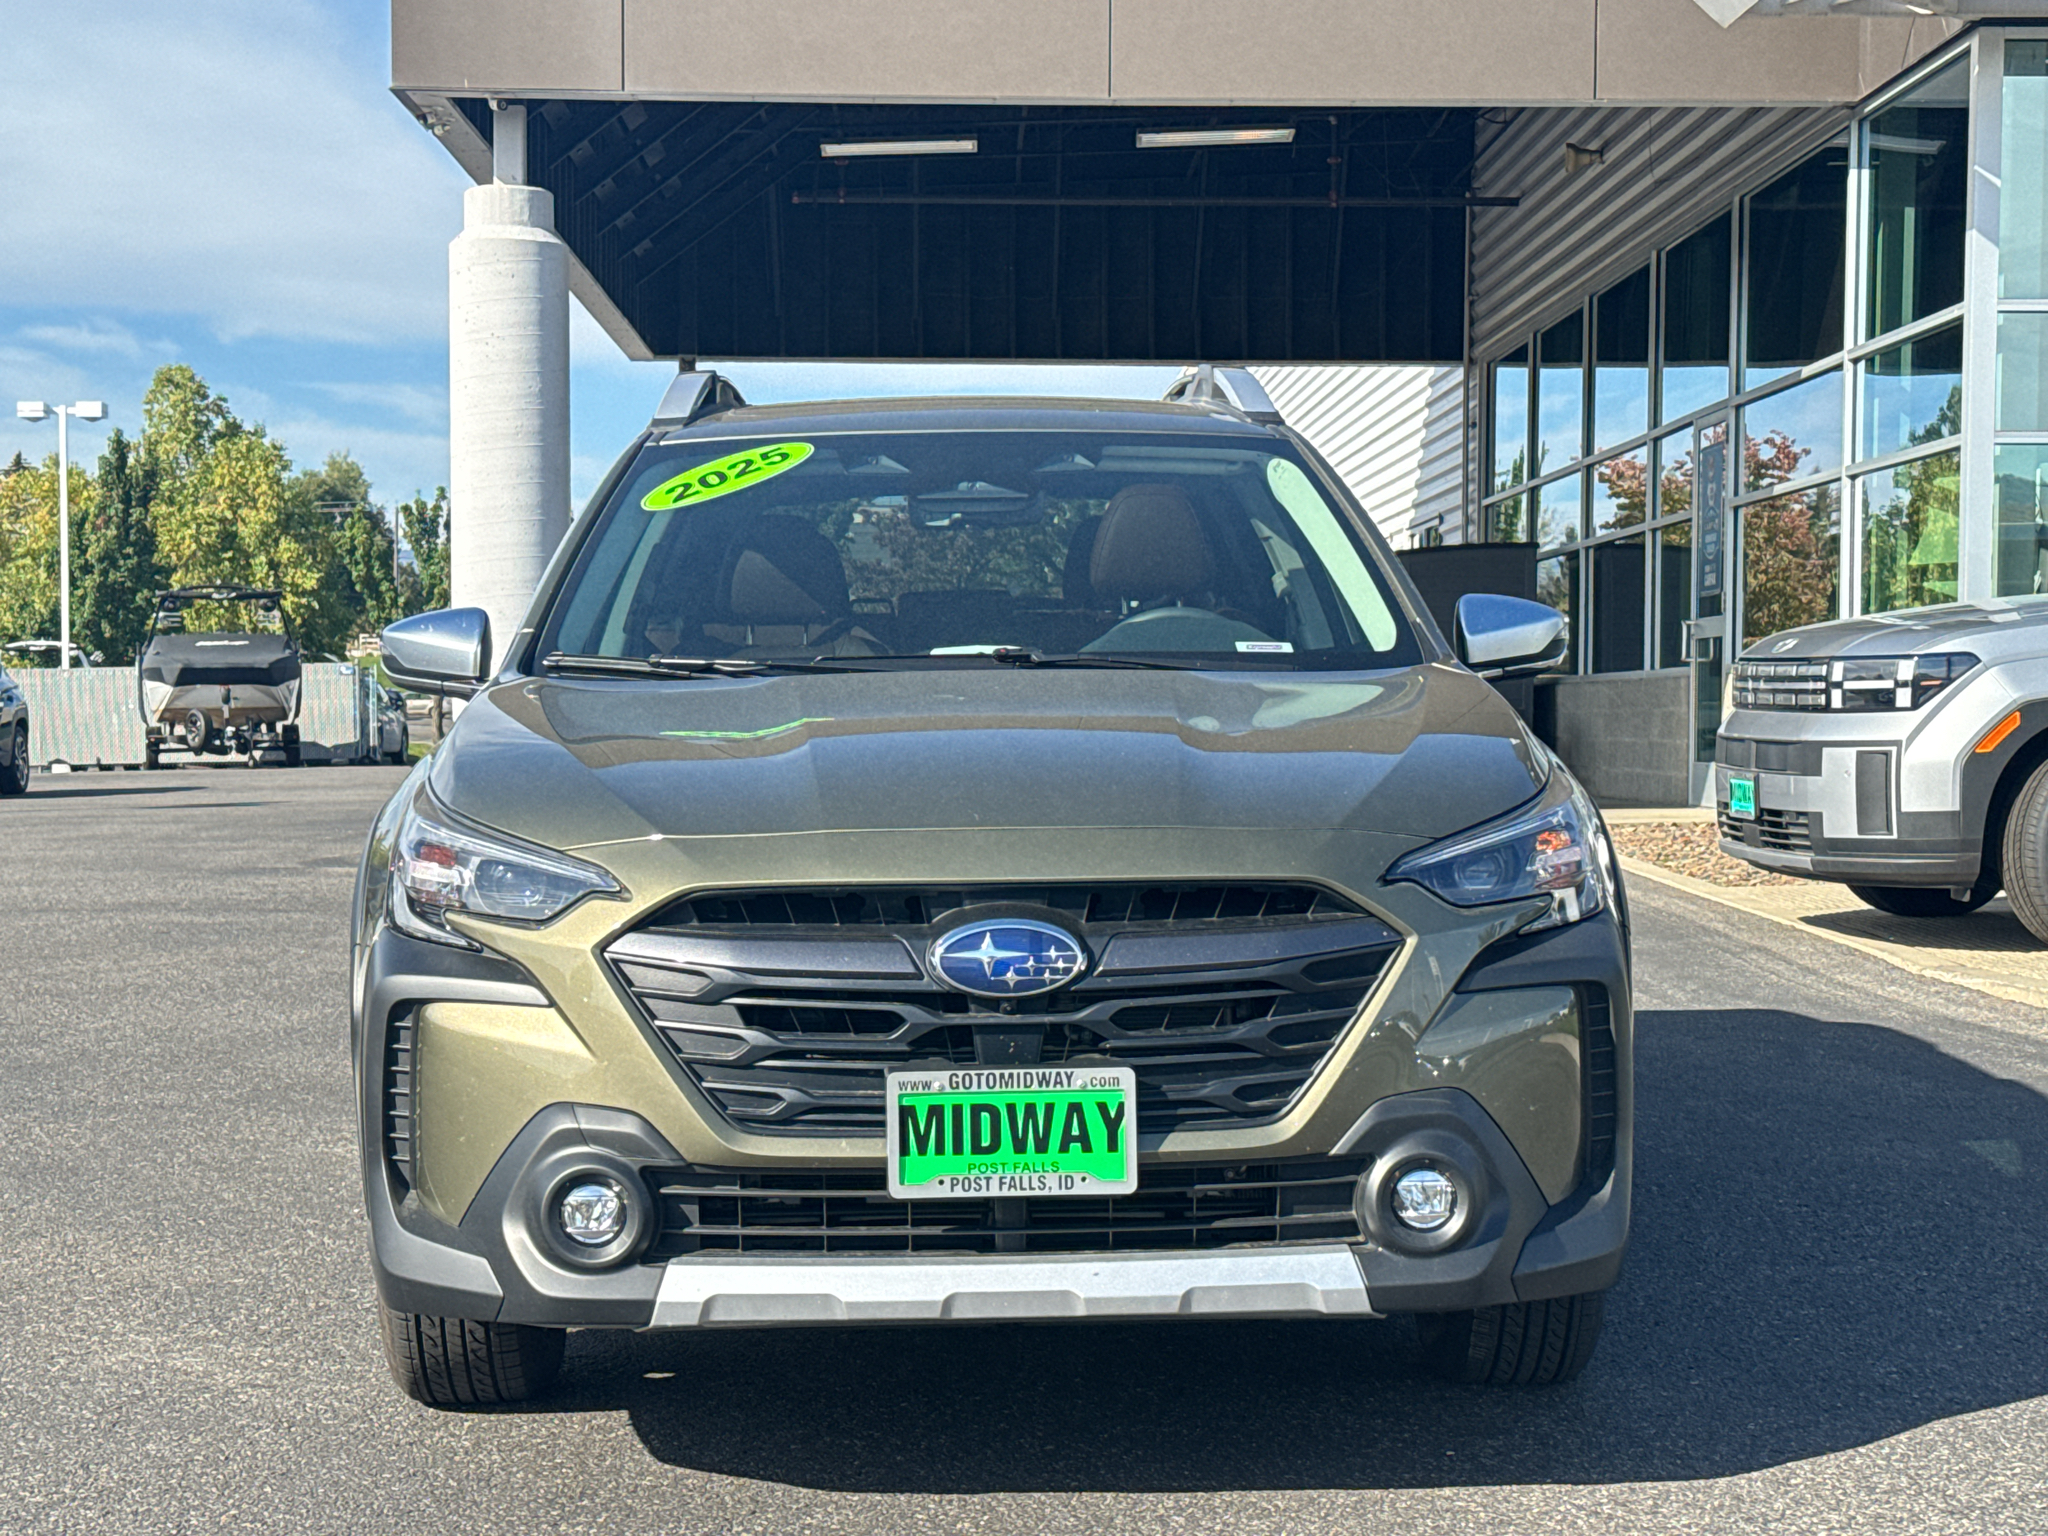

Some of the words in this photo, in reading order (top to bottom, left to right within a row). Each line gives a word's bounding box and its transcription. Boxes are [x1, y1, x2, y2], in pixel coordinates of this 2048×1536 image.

[665, 447, 790, 504] 2025
[949, 1071, 1075, 1090] GOTOMIDWAY
[900, 1101, 1125, 1157] MIDWAY
[967, 1162, 1007, 1174] POST
[1013, 1161, 1060, 1173] FALLS
[950, 1176, 993, 1192] POST
[998, 1175, 1052, 1192] FALLS,
[1058, 1174, 1075, 1191] ID
